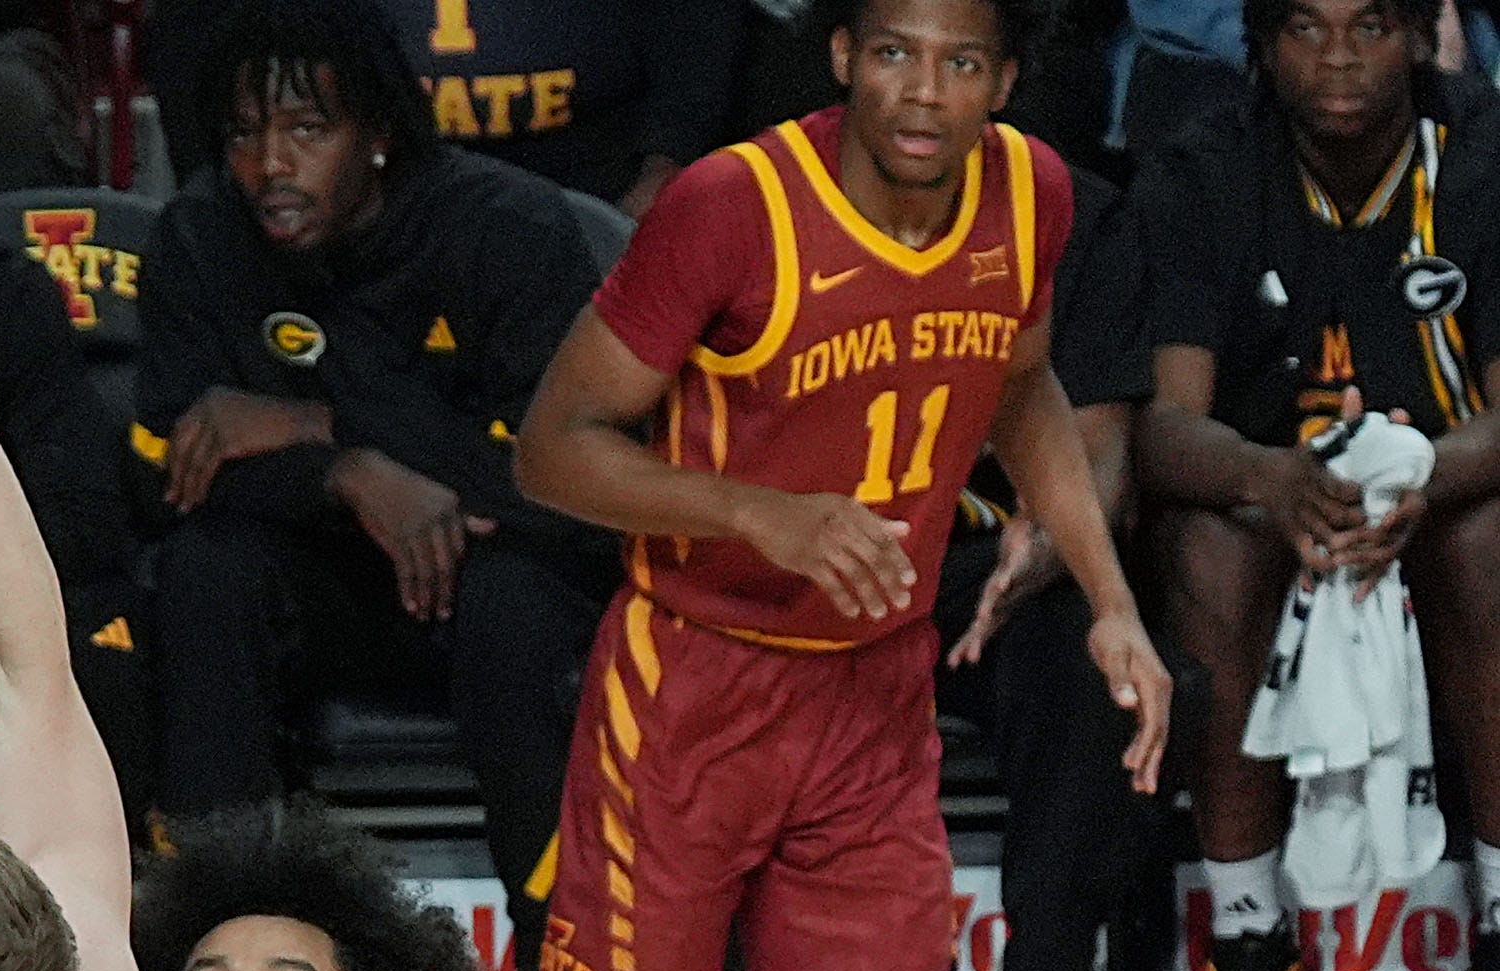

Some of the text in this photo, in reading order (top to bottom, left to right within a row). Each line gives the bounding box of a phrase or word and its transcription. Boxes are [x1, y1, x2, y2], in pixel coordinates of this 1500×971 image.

[417, 67, 576, 137] ATE
[24, 244, 140, 300] ATE
[785, 310, 1019, 400] IOWA STATE
[853, 383, 951, 503] 11
